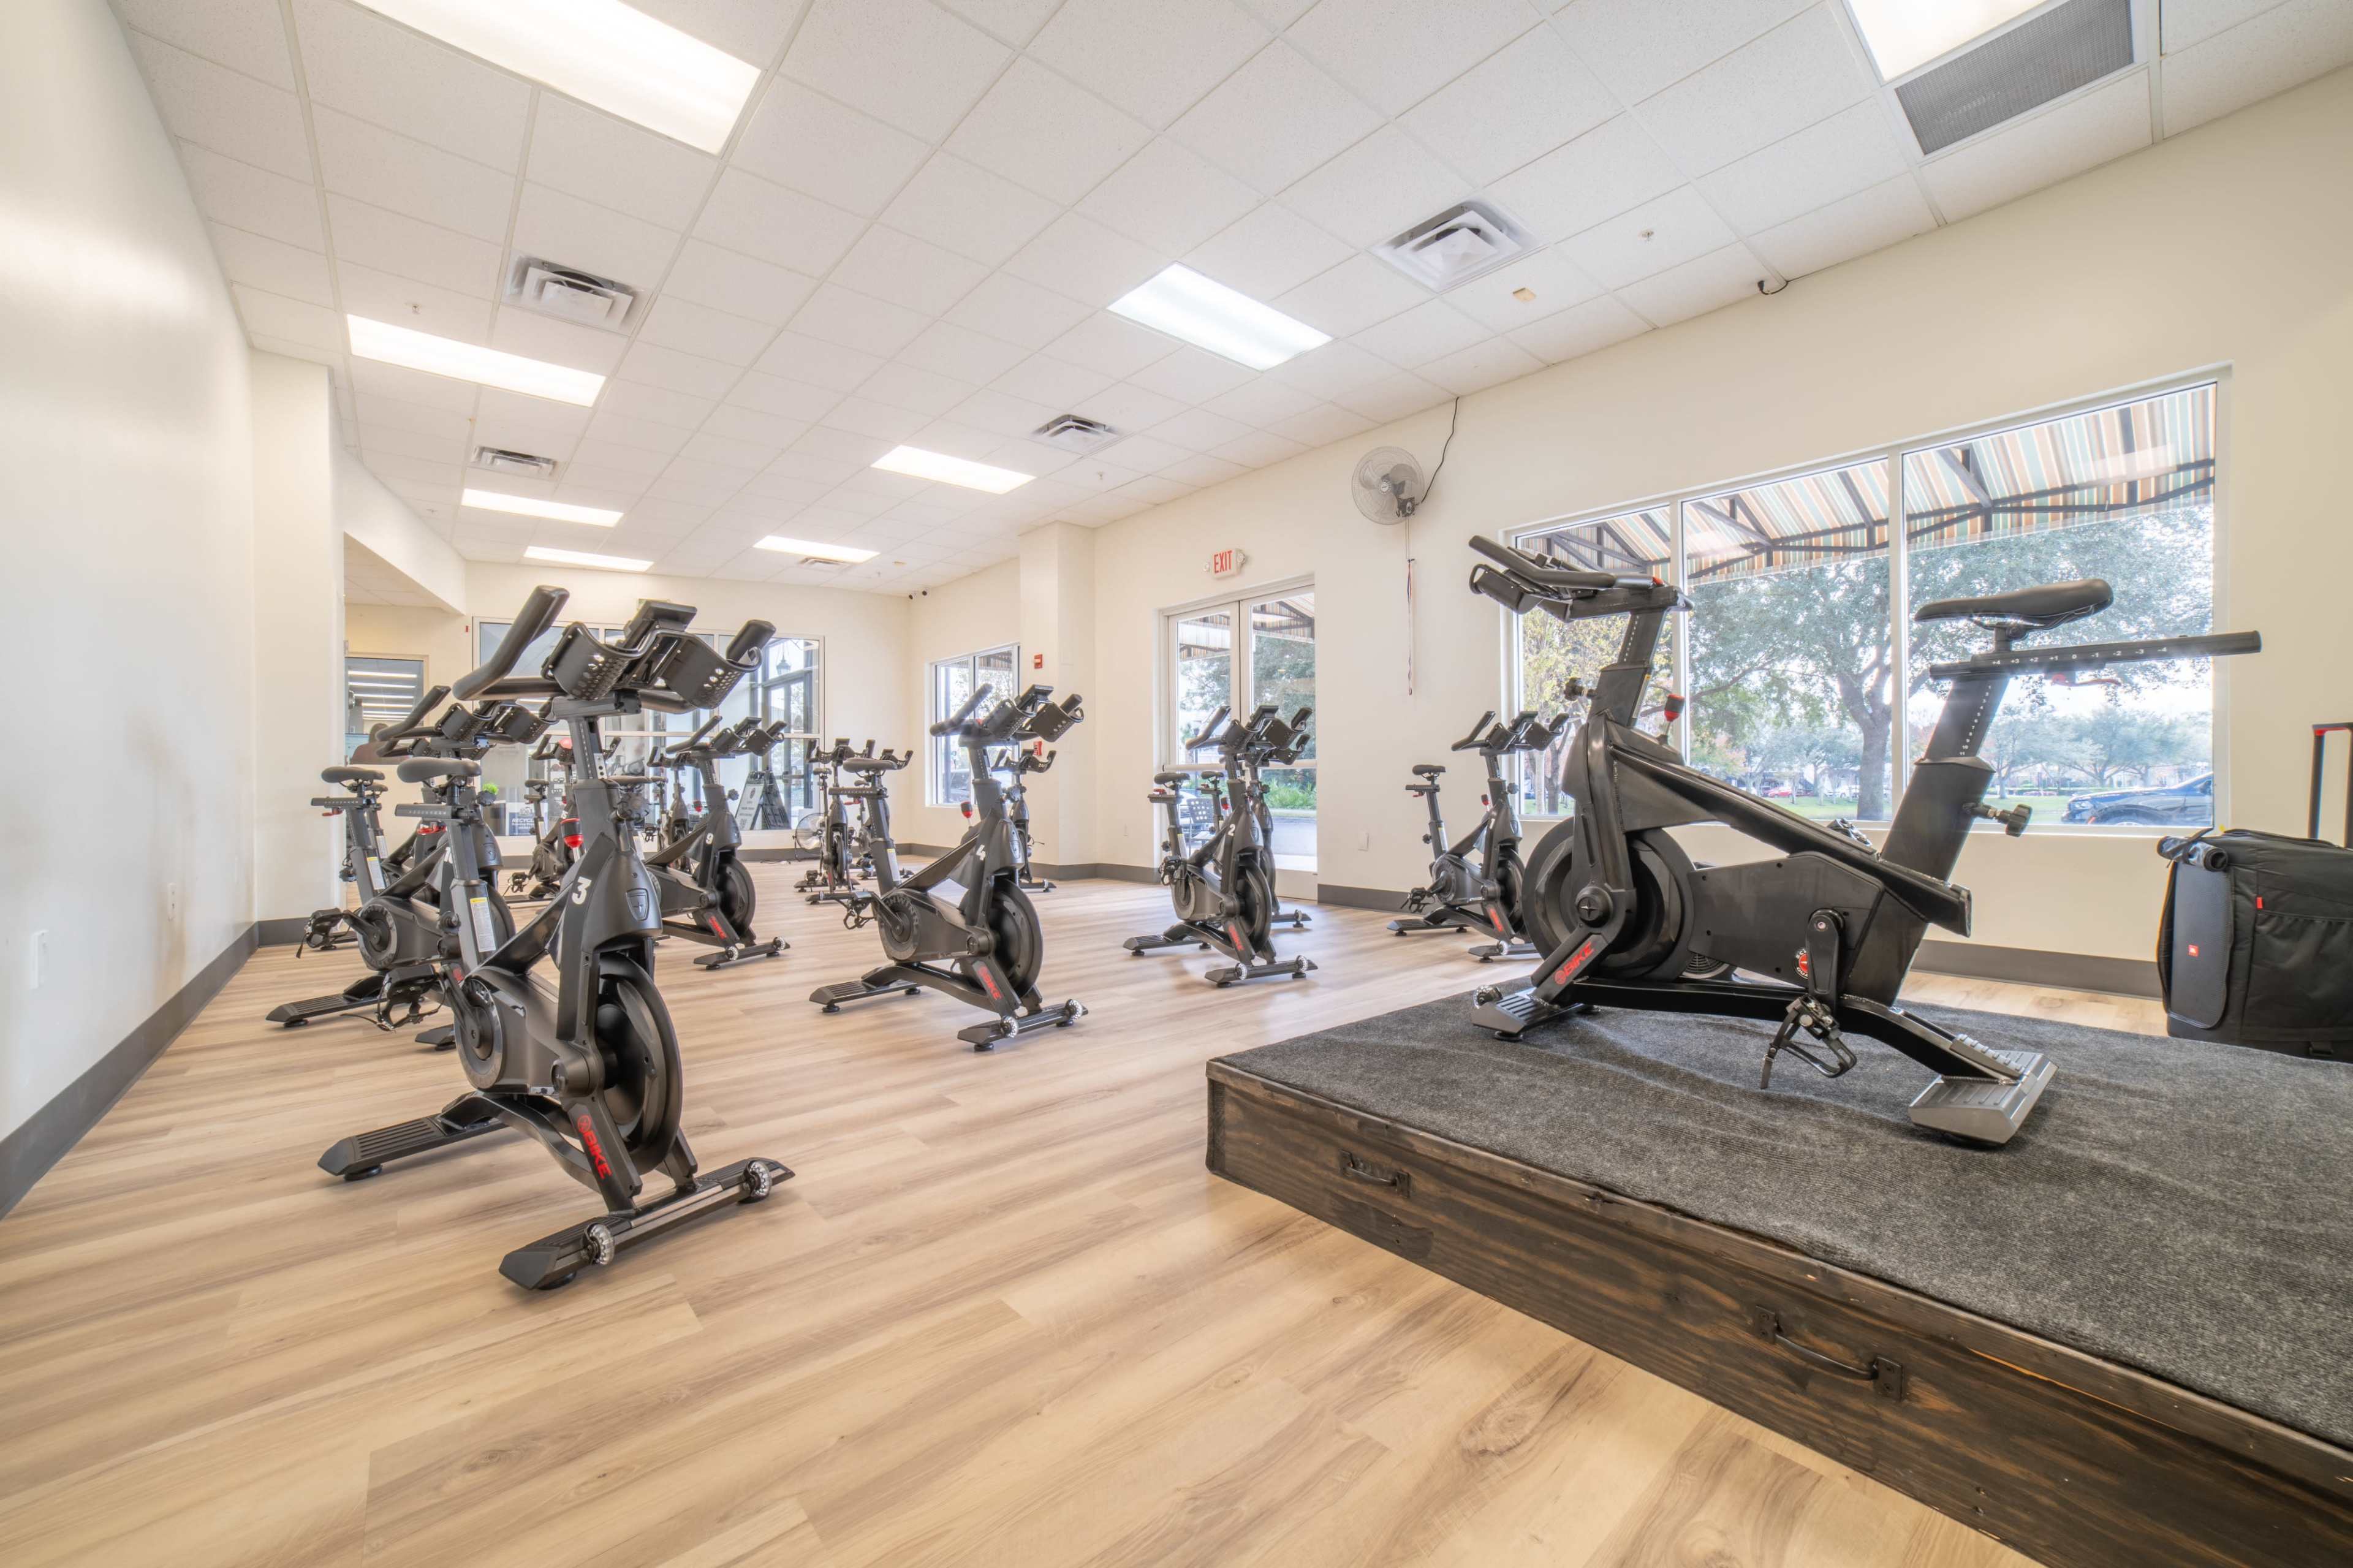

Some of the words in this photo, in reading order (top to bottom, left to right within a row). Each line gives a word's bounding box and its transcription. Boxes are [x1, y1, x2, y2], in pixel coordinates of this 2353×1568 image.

[1213, 550, 1233, 574] EXIT
[1227, 824, 1236, 836] 2
[1490, 818, 1495, 829] 1
[705, 833, 714, 845] 9
[976, 844, 986, 861] 4
[572, 876, 592, 904] 3
[1564, 941, 1595, 976] BIKE
[583, 1130, 613, 1180] BIKE
